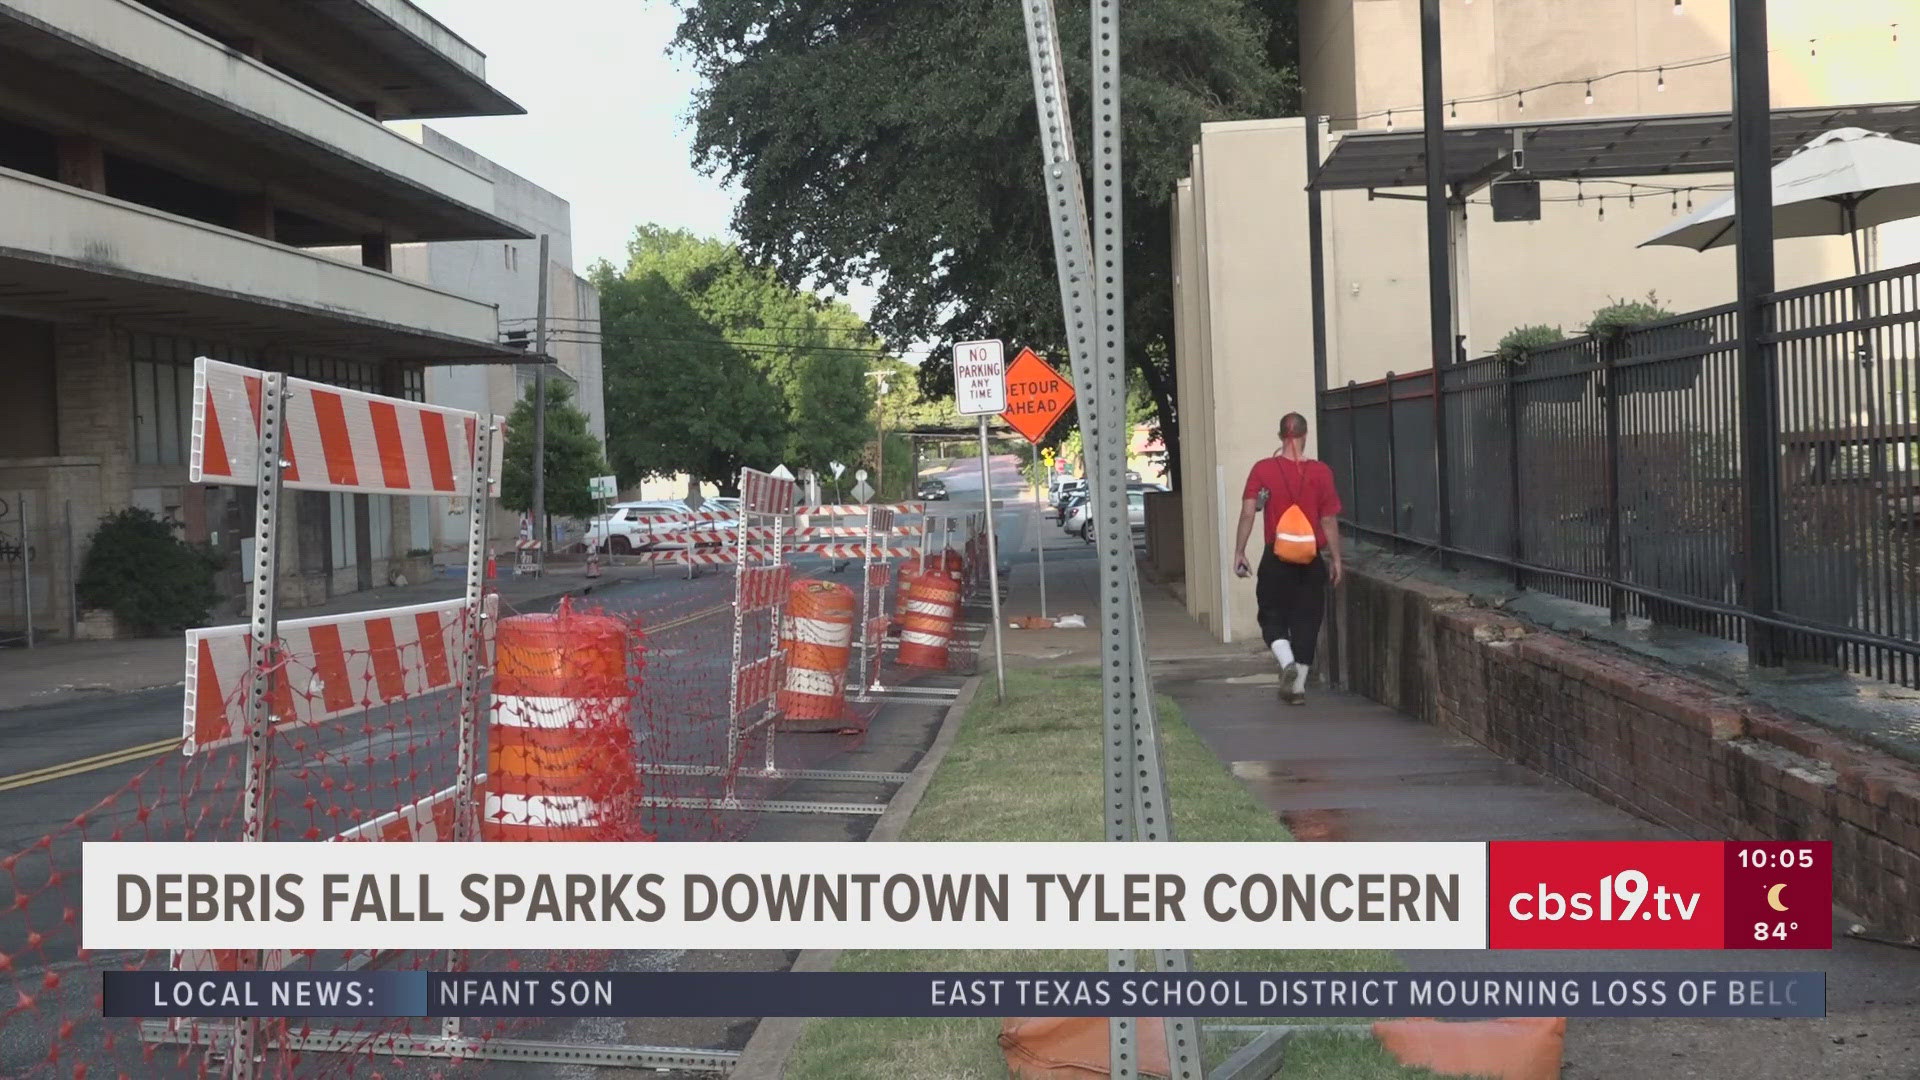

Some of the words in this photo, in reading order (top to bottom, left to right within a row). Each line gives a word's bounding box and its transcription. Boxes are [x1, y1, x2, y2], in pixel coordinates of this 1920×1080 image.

[969, 348, 987, 362] NO
[959, 363, 1001, 378] PARKING
[971, 379, 990, 388] ANY
[970, 389, 992, 399] TIME
[1006, 399, 1057, 415] AHEAD
